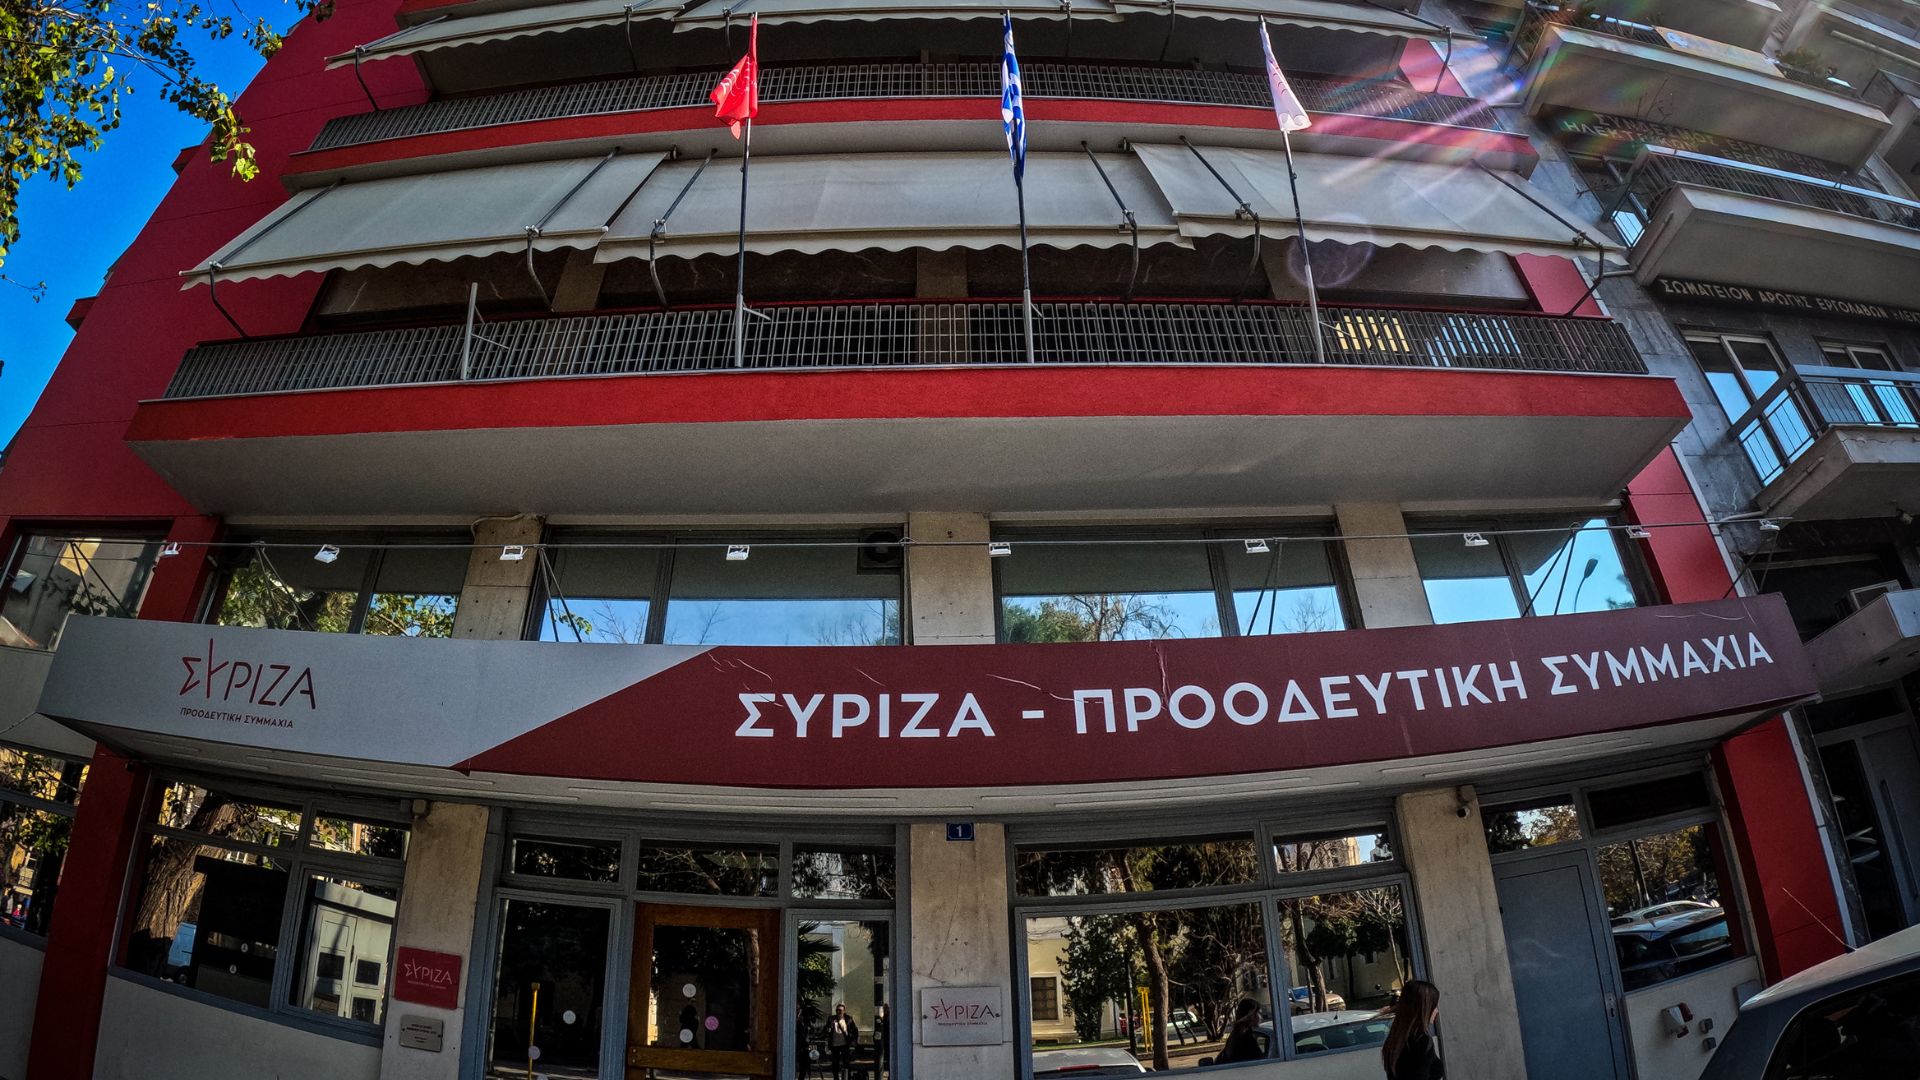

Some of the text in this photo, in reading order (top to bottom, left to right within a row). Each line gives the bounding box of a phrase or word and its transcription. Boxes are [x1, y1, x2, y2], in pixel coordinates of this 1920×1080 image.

[1660, 278, 1753, 302] ΣΩΜΑΤΕΙΟΝ
[1757, 290, 1813, 309] ΑΡΩΓΗΣ
[1817, 297, 1888, 319] ΕΡΓΟΛΑΒΩΝ
[179, 638, 317, 710] ΣΥΡΙΖΑ
[735, 692, 996, 738] ΣΥΡΙΖΑ
[1073, 661, 1528, 735] ΠΡΟΟΔΕΥΤΙΚΗ
[1541, 632, 1774, 696] ΣΥΜΜΑΧΙΑ
[179, 706, 294, 729] ΠΡΟΟΔΕΥΤΙΚΗ ΣΥΜΜΑΧΙΑ
[956, 825, 963, 838] 1
[403, 957, 453, 985] ΣΥΡΙΖΑ
[930, 998, 995, 1020] ΣΥΡΙΖΑ
